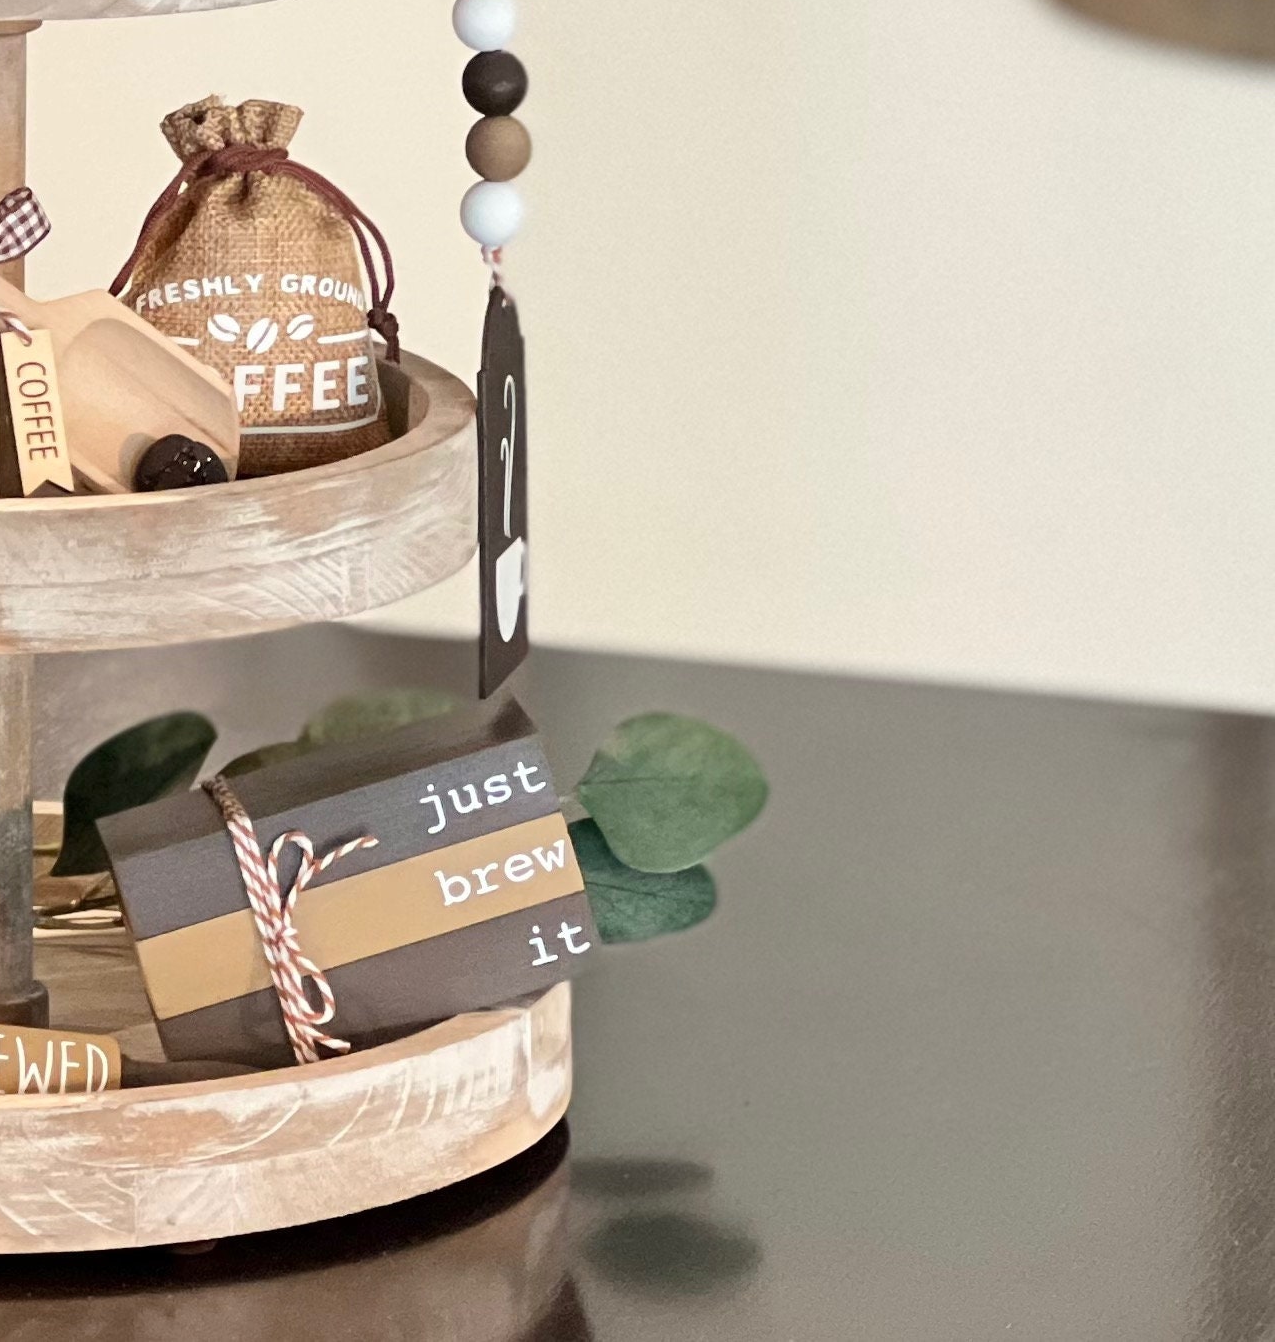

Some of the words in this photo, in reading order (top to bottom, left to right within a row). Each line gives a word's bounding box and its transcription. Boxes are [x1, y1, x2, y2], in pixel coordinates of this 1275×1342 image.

[136, 273, 264, 314] FRESHLY
[280, 273, 366, 312] GROUND
[15, 361, 59, 462] COFFEE
[234, 356, 370, 412] FFEE
[419, 761, 547, 835] just
[433, 839, 567, 906] brew
[528, 920, 592, 966] it
